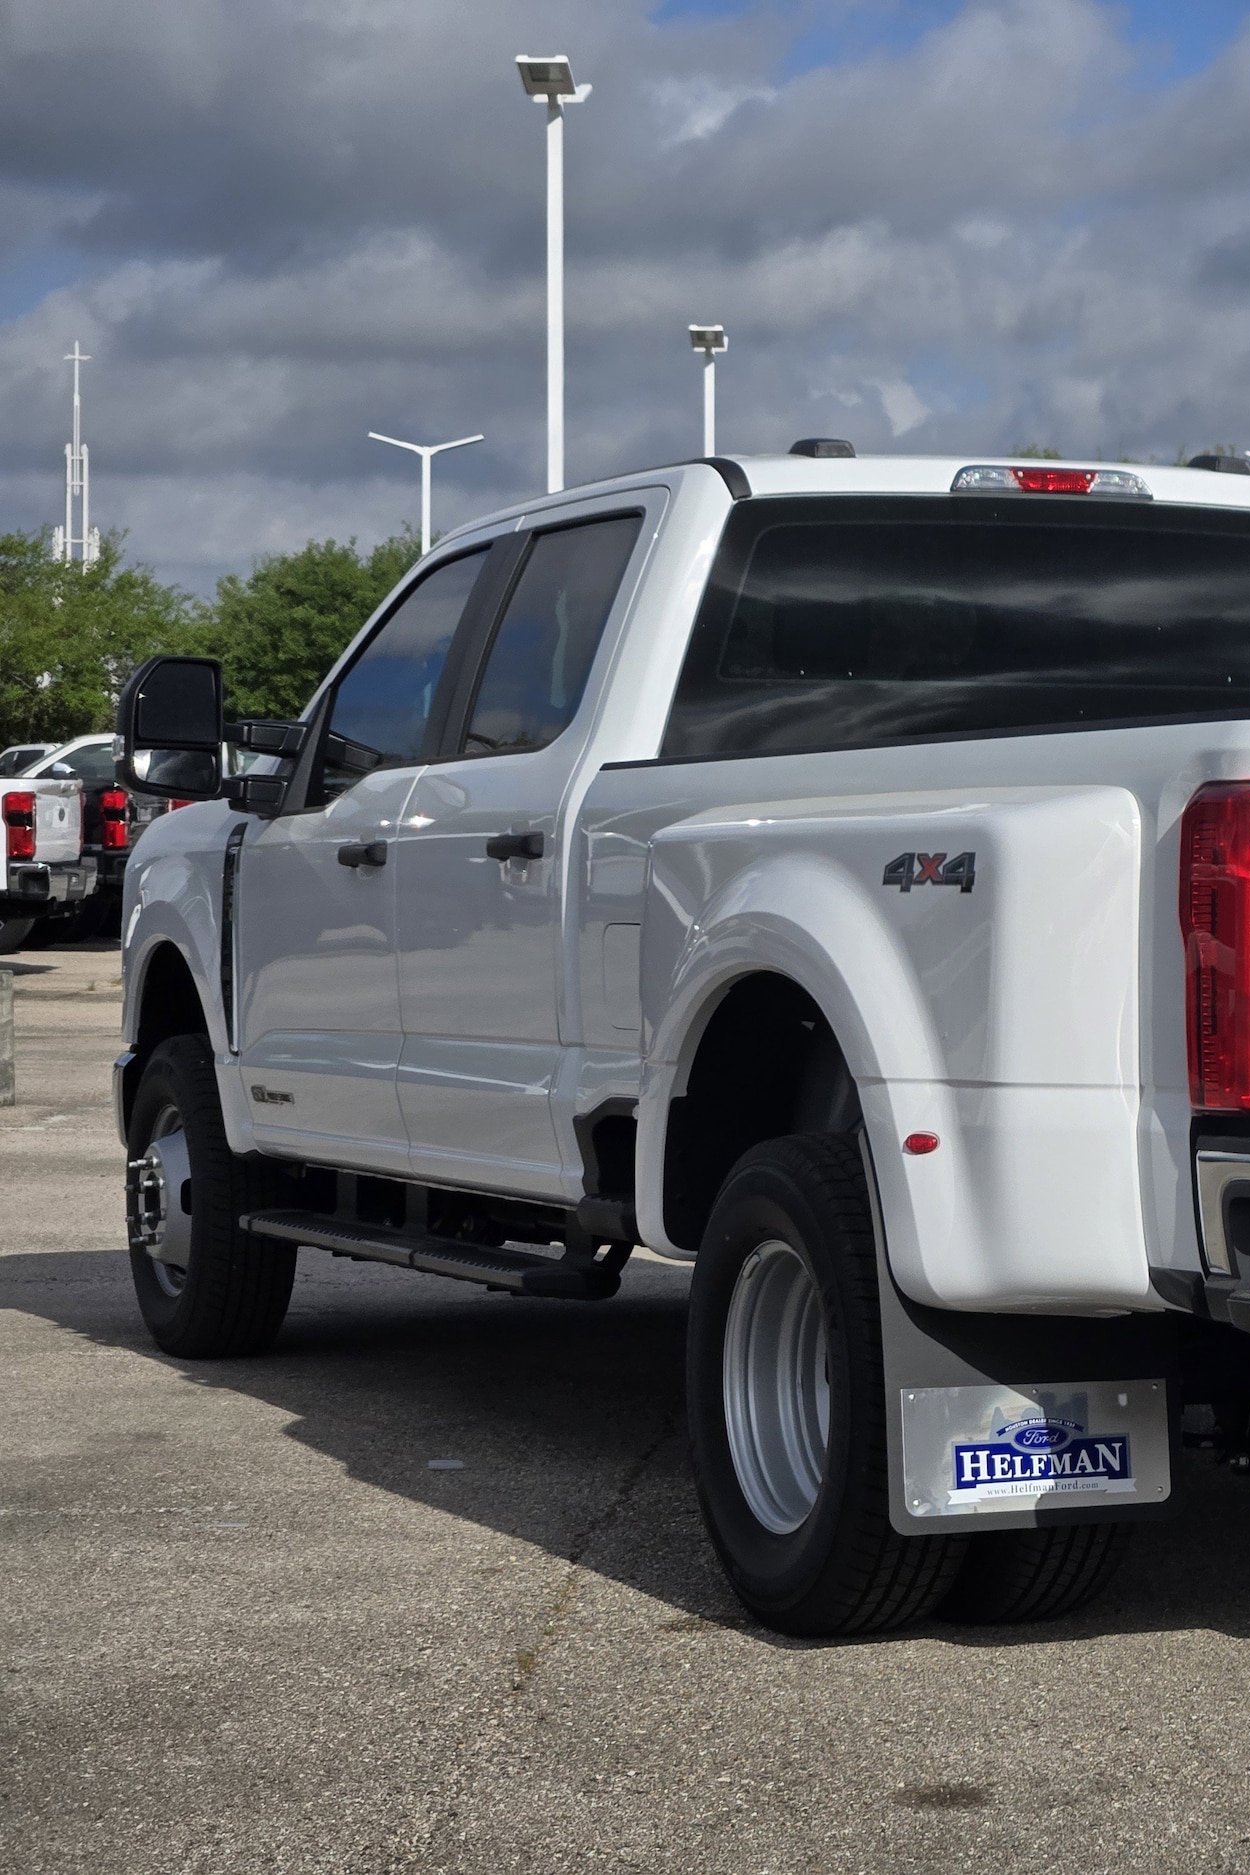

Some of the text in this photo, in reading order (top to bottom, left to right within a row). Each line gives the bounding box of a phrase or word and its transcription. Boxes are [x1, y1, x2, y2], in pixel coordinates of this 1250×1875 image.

[1022, 1429, 1060, 1445] Ford
[959, 1441, 1123, 1482] HELFMAN
[987, 1480, 1099, 1496] www.HelfmanFord.com
